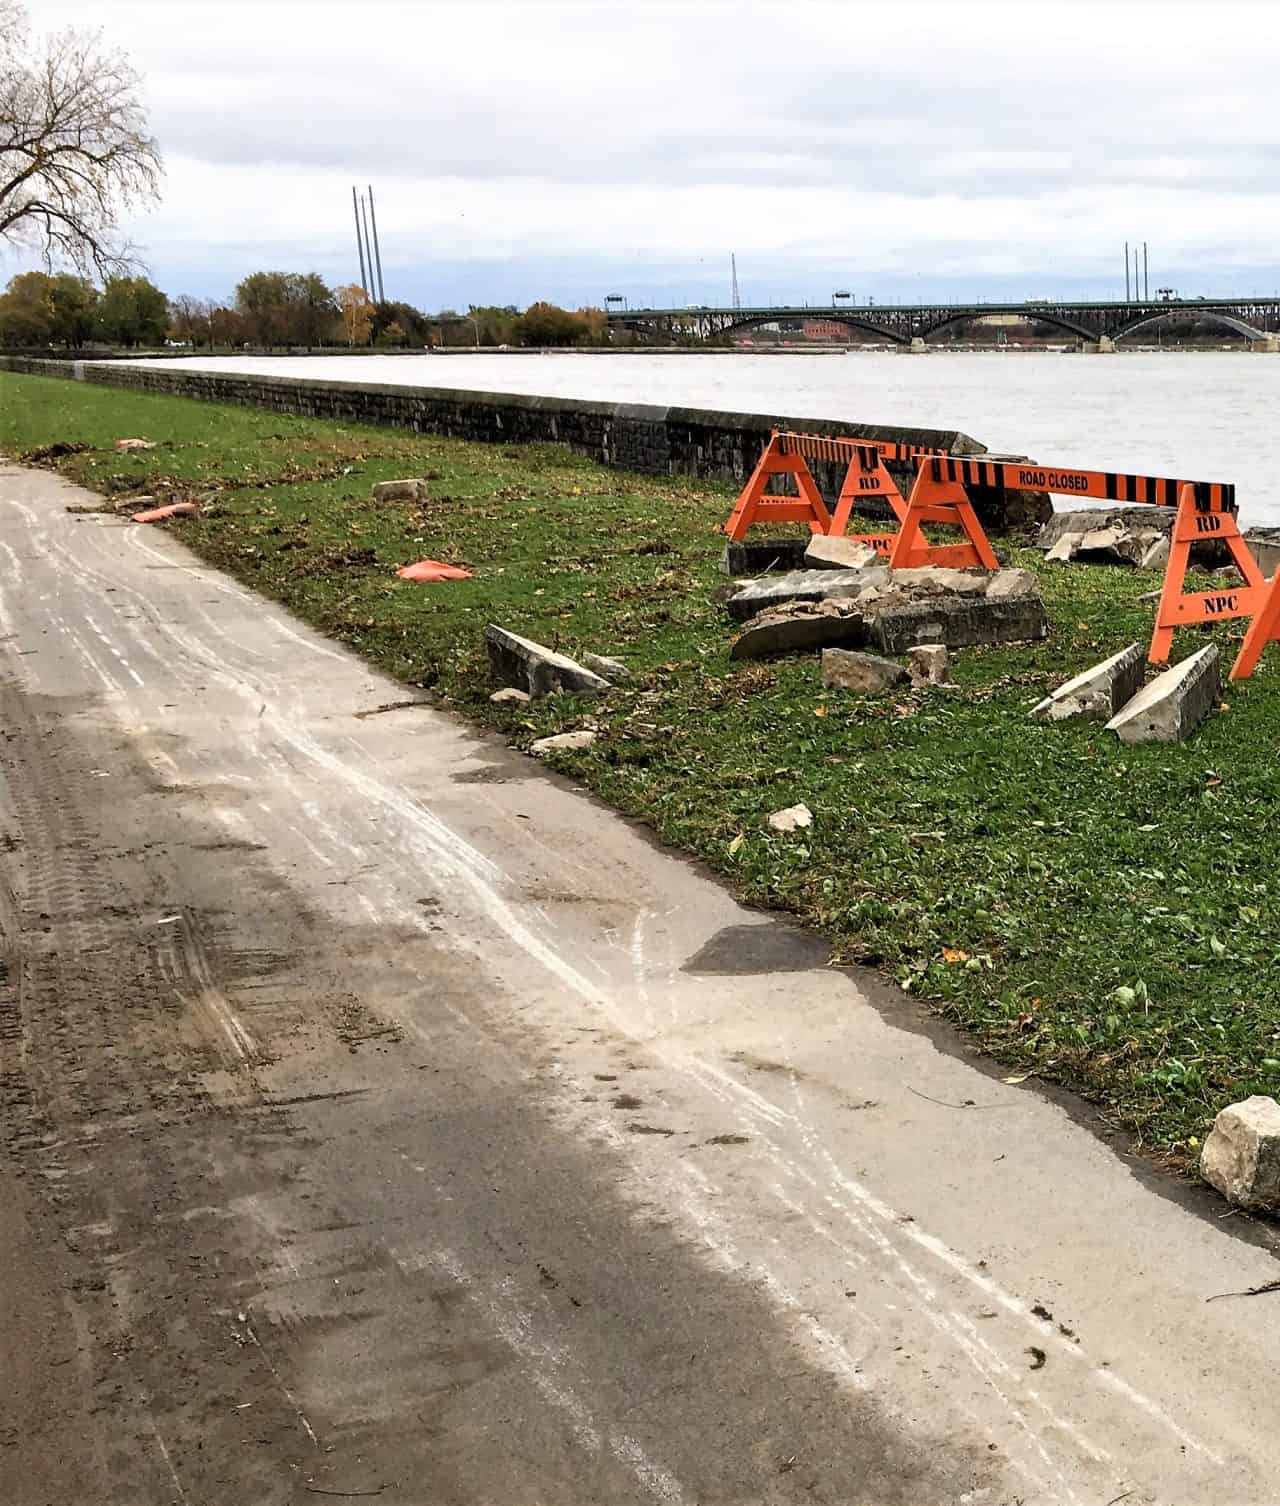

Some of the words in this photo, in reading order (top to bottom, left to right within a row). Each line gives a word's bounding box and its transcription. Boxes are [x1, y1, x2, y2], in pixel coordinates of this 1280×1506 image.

[859, 477, 880, 489] RD
[1019, 470, 1046, 487] ROAD
[1049, 473, 1088, 490] CLOSED
[1196, 514, 1220, 532] RD
[1203, 596, 1239, 614] NPC
